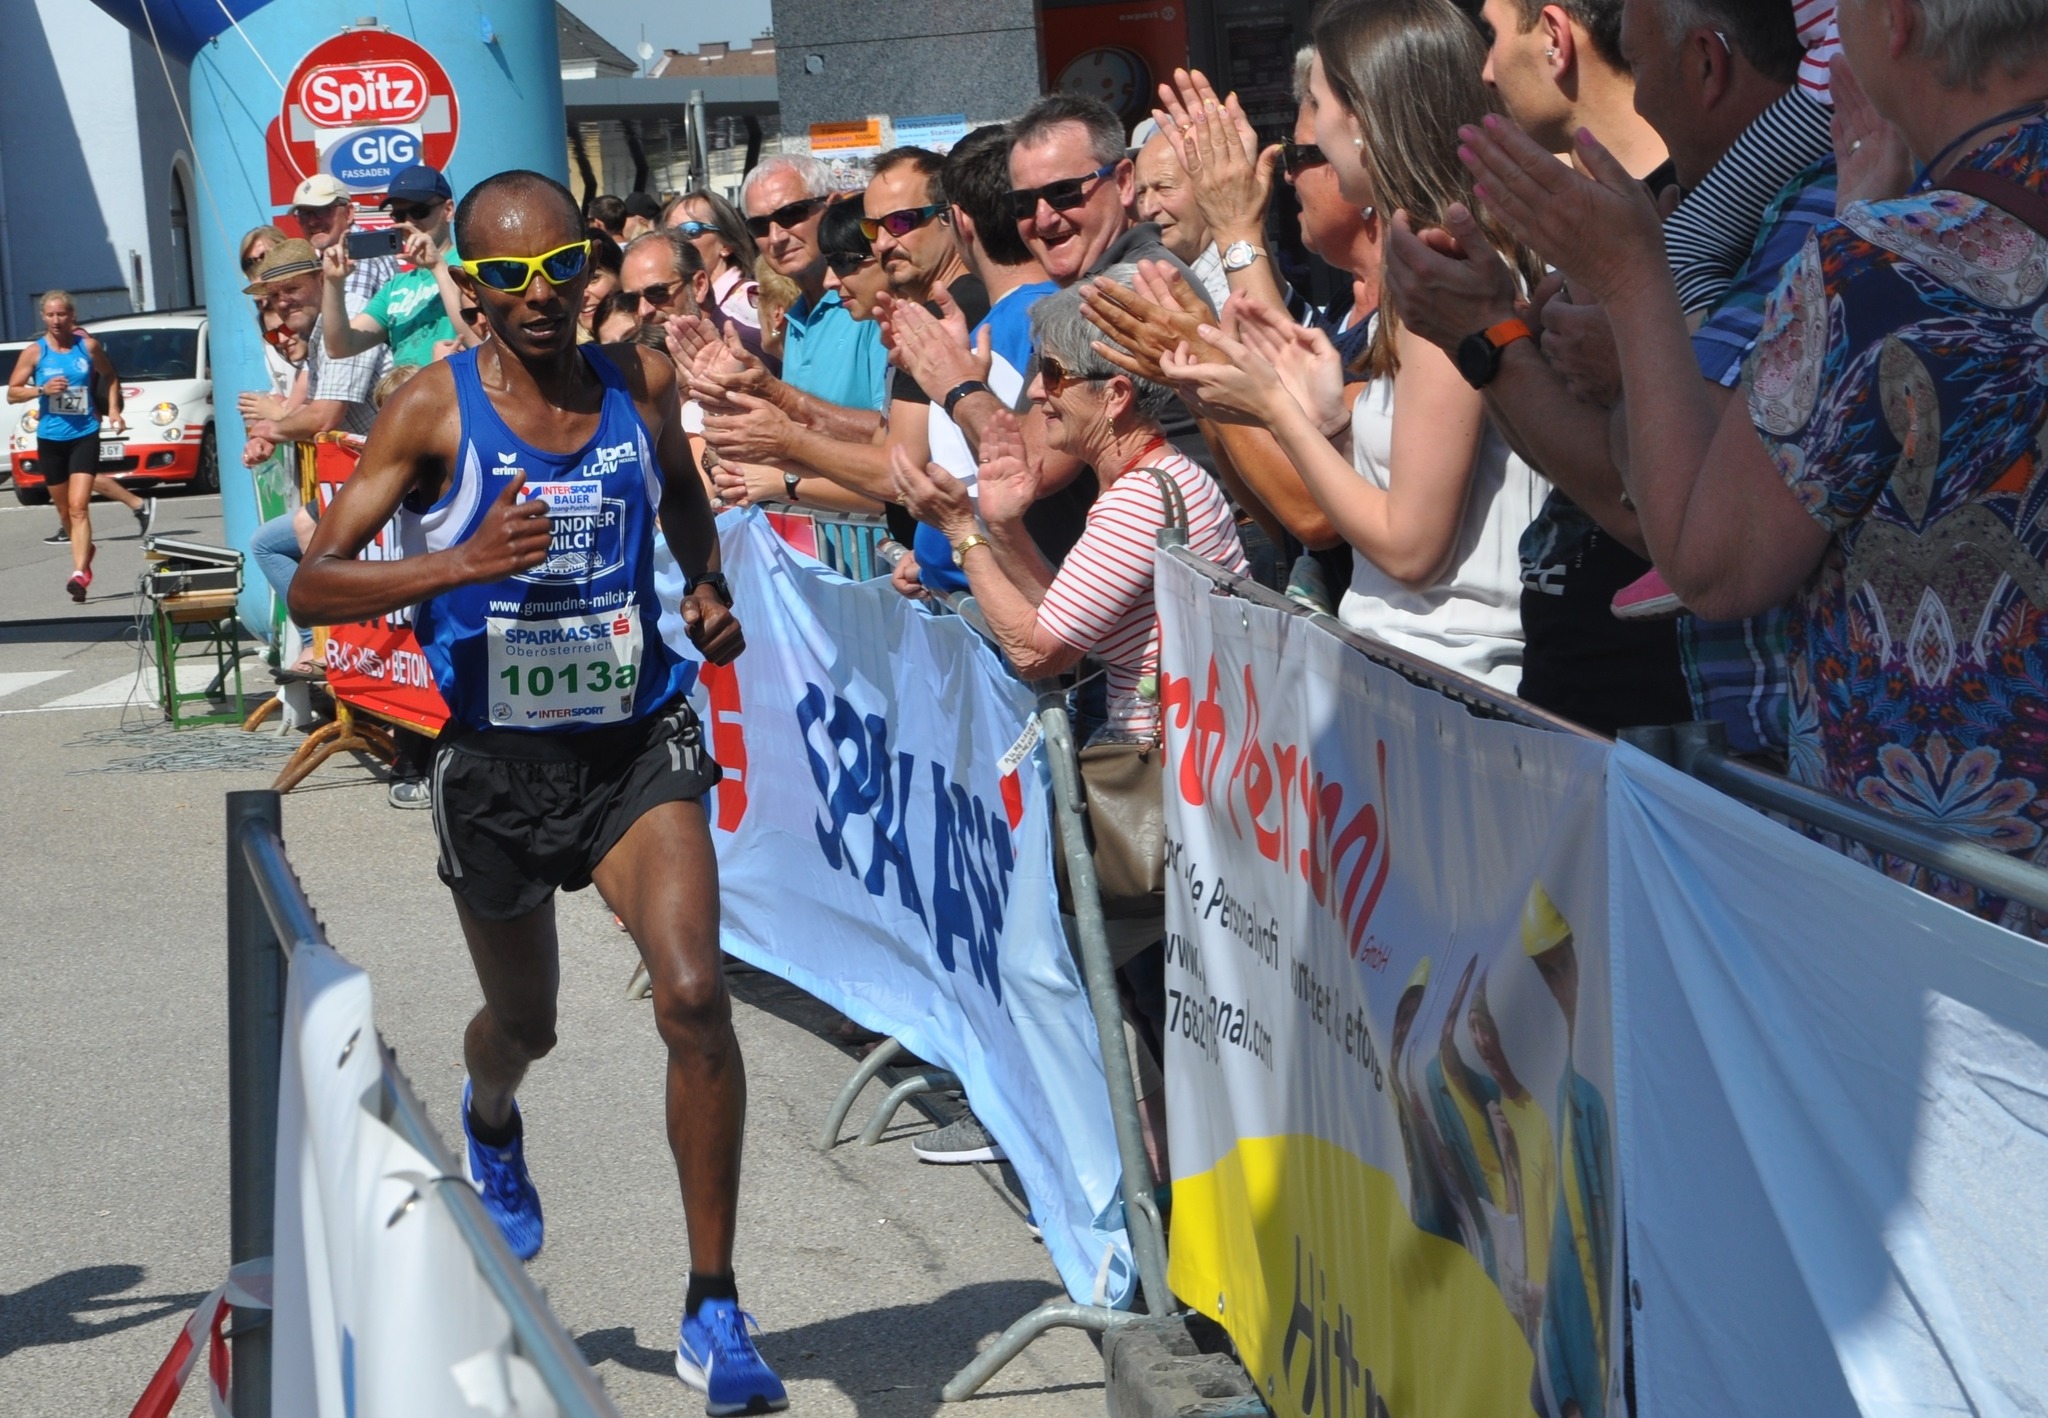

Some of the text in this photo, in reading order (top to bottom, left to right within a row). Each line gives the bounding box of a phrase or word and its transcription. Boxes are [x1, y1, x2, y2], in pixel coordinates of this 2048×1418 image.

[311, 70, 416, 120] Spitz
[352, 134, 414, 165] GIG
[341, 167, 391, 179] FASSADEN
[55, 396, 82, 410] 127
[492, 465, 525, 476] erim
[582, 460, 619, 477] LCAV
[542, 484, 598, 495] INTERSPORT
[554, 494, 590, 505] BAUER
[549, 511, 616, 535] UNDNER
[505, 622, 611, 646] SPARKASSE
[505, 641, 612, 657] Oberösterreich
[391, 649, 429, 689] BETON
[500, 660, 637, 697] 1013a
[538, 706, 606, 719] INTERSPORT
